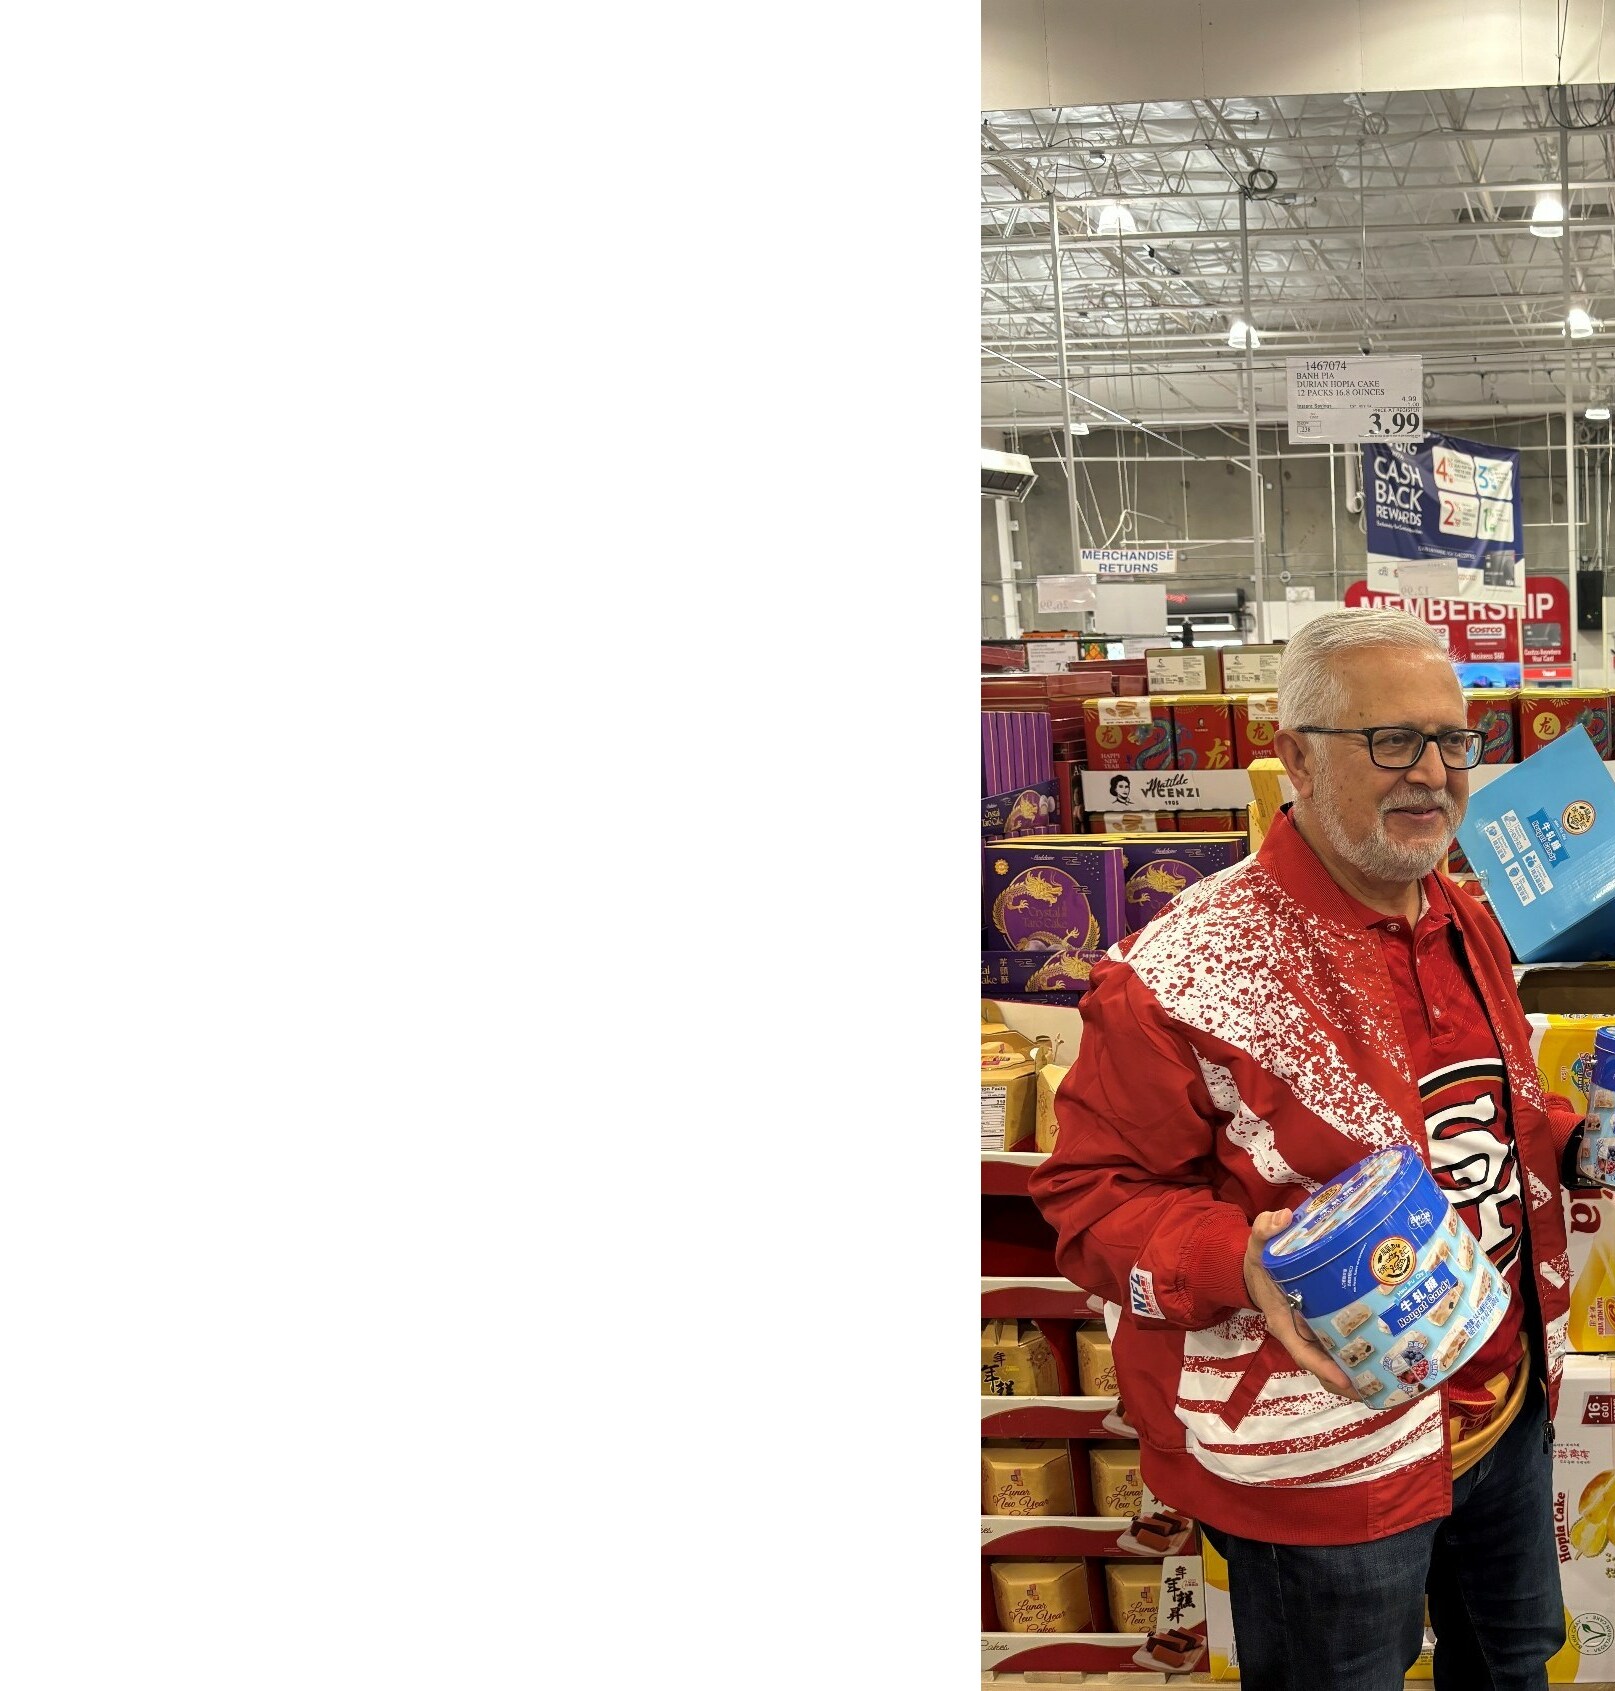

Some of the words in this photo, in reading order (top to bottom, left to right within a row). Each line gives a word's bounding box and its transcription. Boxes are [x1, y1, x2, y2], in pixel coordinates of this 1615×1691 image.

[1305, 361, 1347, 371] 1467074
[1296, 372, 1319, 380] BANH
[1321, 372, 1335, 380] PIA
[1368, 412, 1420, 434] 3.99
[1374, 456, 1424, 488] CASH
[1375, 480, 1424, 512] BACK
[1376, 505, 1422, 527] REWARDS
[1082, 550, 1174, 561] MERCHANDISE
[1099, 563, 1158, 573] RETURNS
[1468, 626, 1503, 635] COSTCO
[1538, 719, 1555, 735] 龙
[1101, 728, 1117, 744] 龙
[1147, 773, 1188, 790] Matilde
[1141, 788, 1200, 798] VICENZI
[981, 976, 998, 985] ake
[1131, 1274, 1151, 1314] NFL
[1400, 1276, 1439, 1313] 牛轧糖
[1398, 1300, 1427, 1328] Nougat
[1428, 1279, 1451, 1303] Candy
[1588, 1402, 1601, 1419] 16
[998, 1485, 1031, 1498] Lunar
[1113, 1485, 1144, 1498] Lunar
[993, 1496, 1015, 1509] New
[1018, 1496, 1049, 1513] Year
[1106, 1496, 1129, 1509] New
[1553, 1491, 1566, 1524] Cake
[1556, 1527, 1572, 1564] Hopia
[1015, 1600, 1048, 1613] Lunar
[1130, 1601, 1158, 1615] Lunar
[1009, 1611, 1033, 1624] New
[1036, 1610, 1066, 1627] Year
[1122, 1612, 1146, 1625] New
[1593, 1624, 1612, 1654] VEGETARIAN
